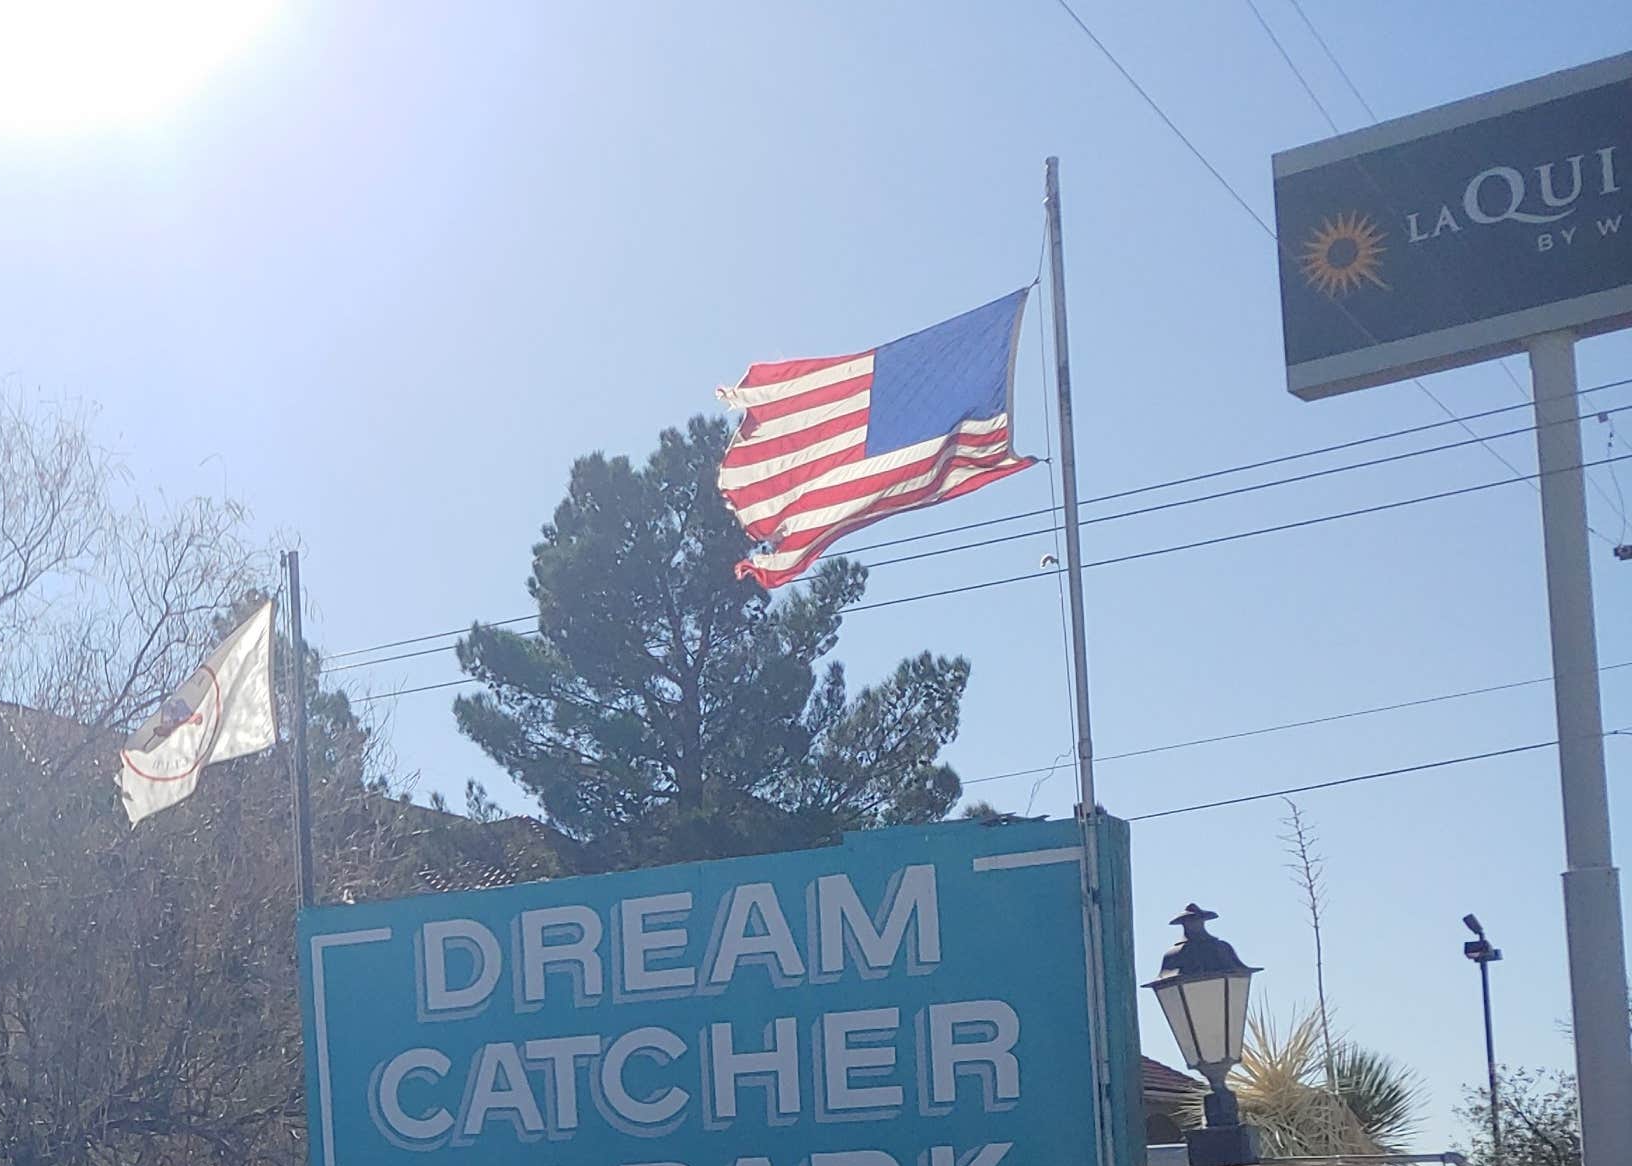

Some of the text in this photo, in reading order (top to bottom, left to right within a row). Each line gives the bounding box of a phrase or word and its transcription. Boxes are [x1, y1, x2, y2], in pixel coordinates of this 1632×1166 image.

[1406, 205, 1463, 243] LA
[1537, 226, 1577, 252] BY
[416, 864, 942, 1021] DREAM
[370, 1000, 1021, 1150] CATCHER
